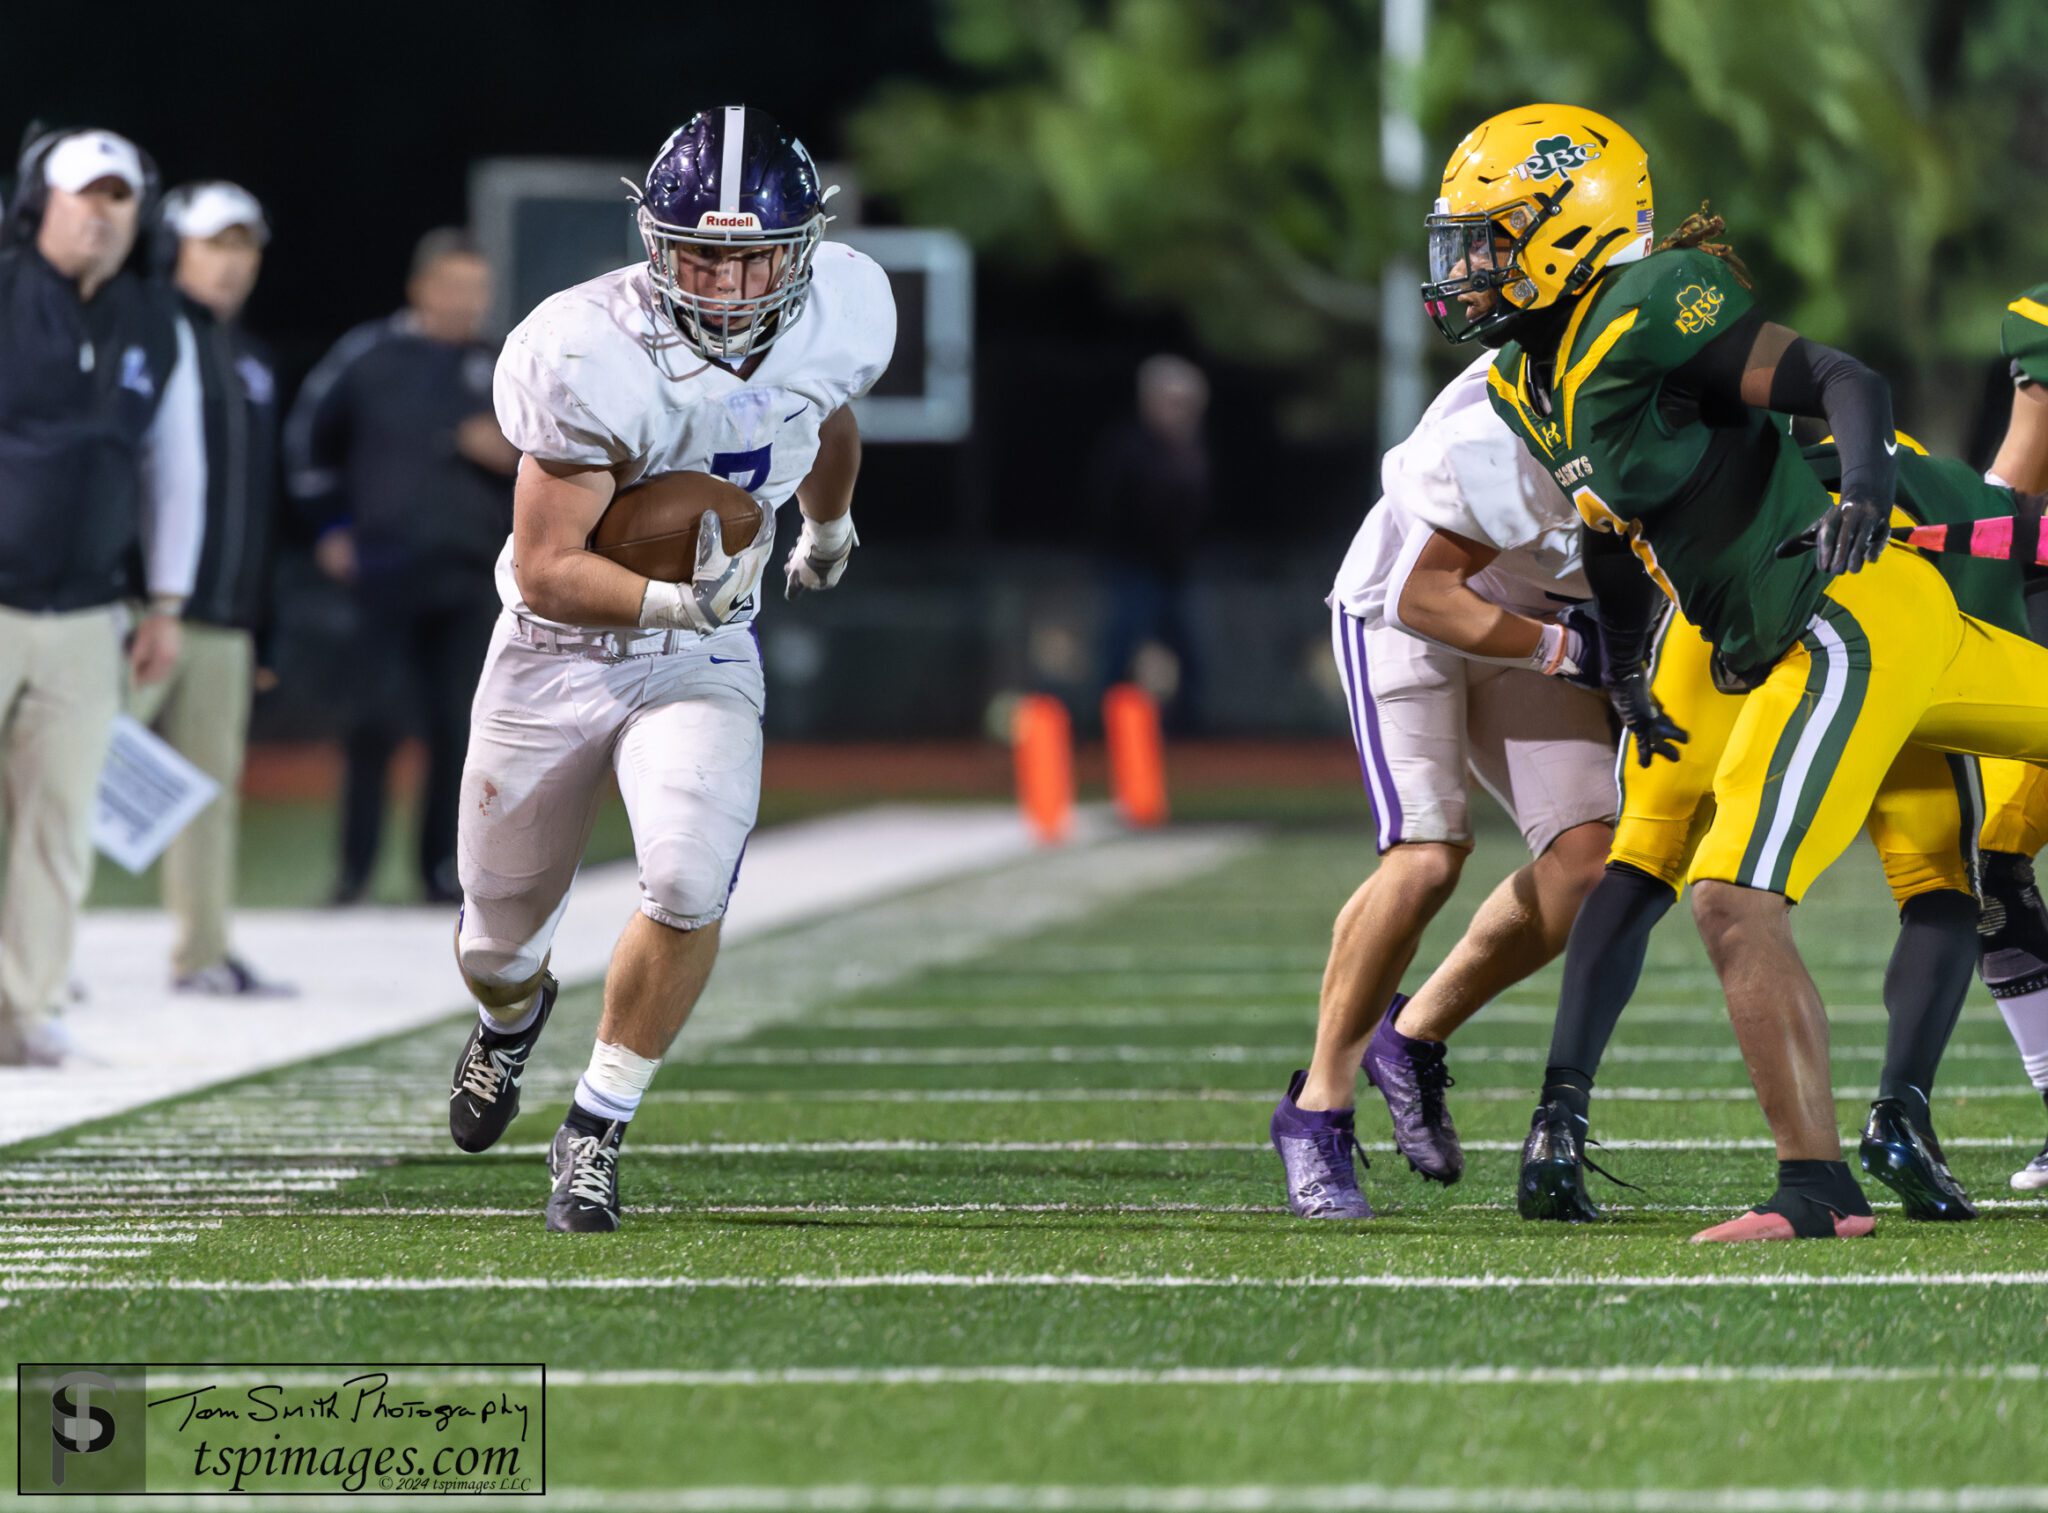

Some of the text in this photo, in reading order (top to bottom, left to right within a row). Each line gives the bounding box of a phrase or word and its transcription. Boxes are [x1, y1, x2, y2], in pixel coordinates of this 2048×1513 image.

[1514, 143, 1601, 181] RBC
[706, 215, 753, 227] Riddell
[1674, 285, 1725, 334] RBC
